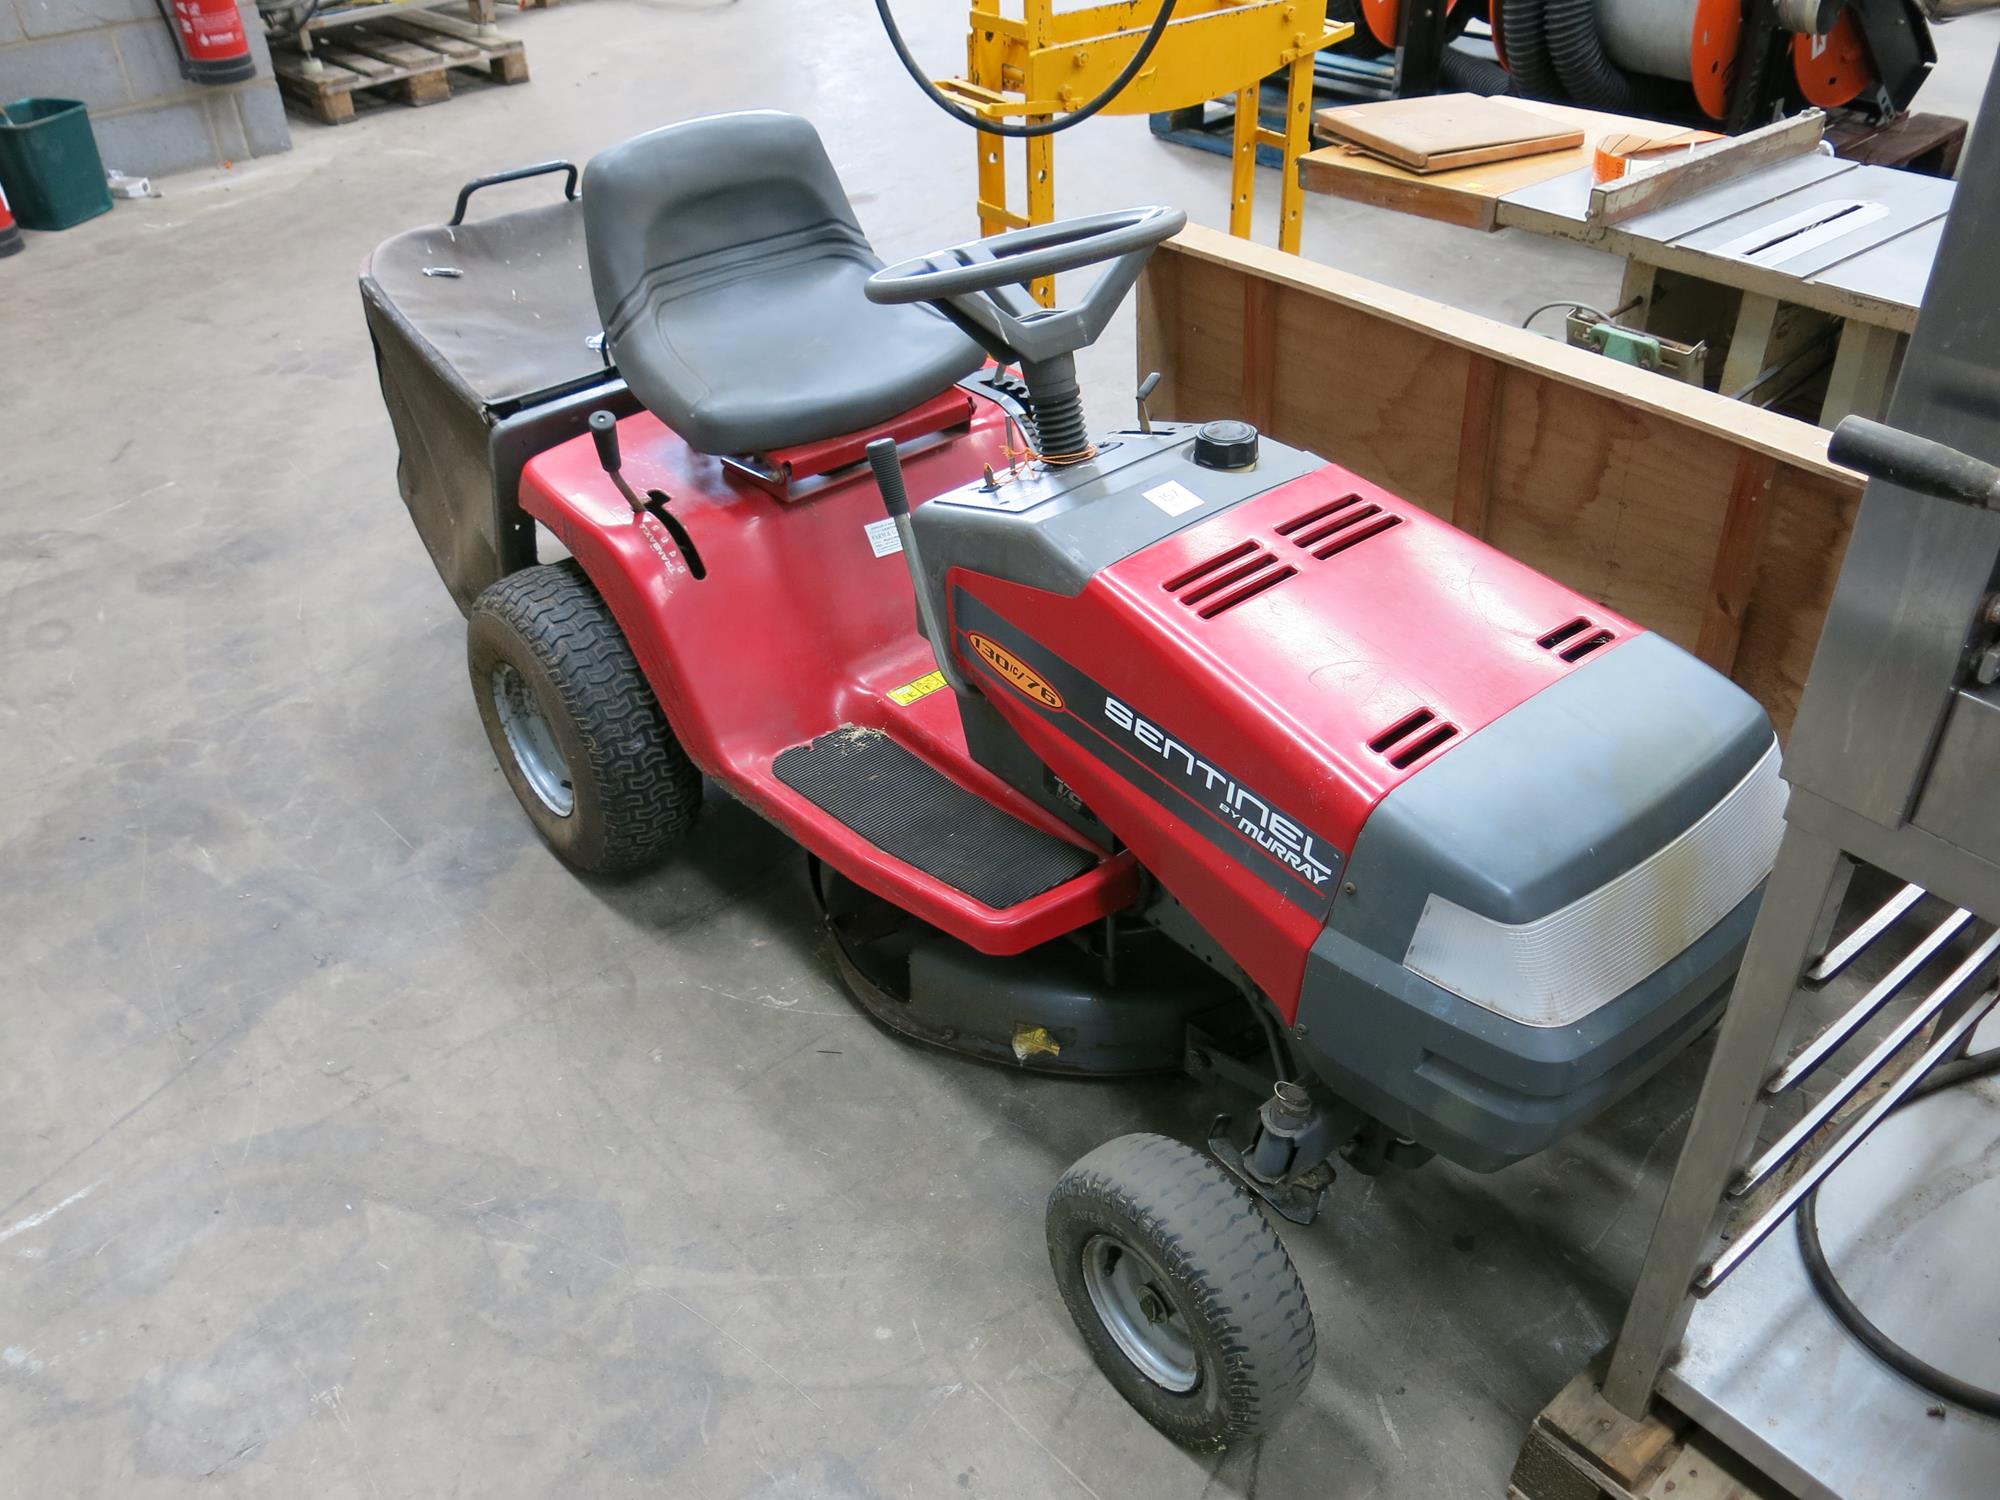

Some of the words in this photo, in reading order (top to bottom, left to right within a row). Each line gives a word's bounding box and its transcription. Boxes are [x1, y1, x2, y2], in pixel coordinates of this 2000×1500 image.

[1104, 696, 1332, 875] SENTINEL
[1218, 802, 1241, 819] BY
[1237, 817, 1329, 885] MURRAY
